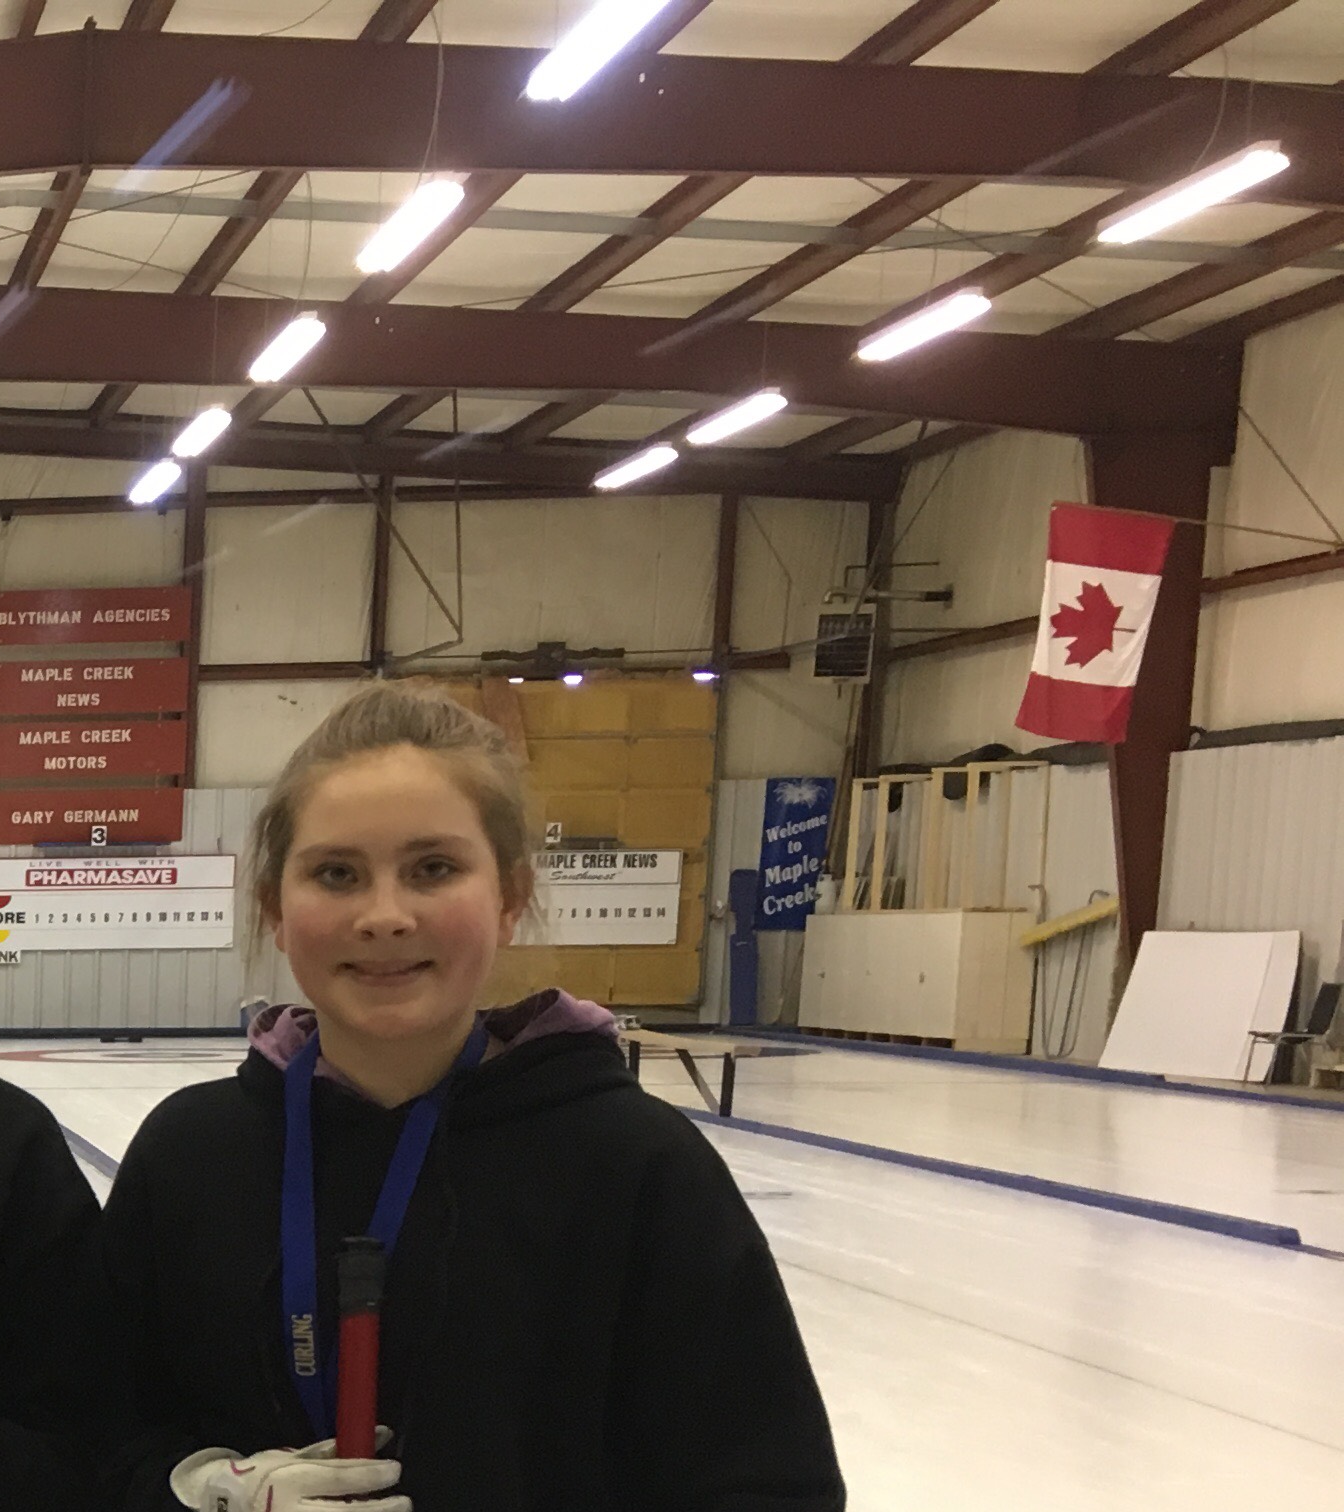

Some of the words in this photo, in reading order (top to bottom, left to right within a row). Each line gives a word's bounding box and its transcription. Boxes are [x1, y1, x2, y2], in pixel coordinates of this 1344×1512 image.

[93, 609, 171, 623] AGENCIES
[21, 668, 73, 682] MAPLE
[83, 666, 135, 681] CREEK
[57, 693, 100, 707] NEWS
[19, 730, 71, 745] MAPLE
[81, 729, 132, 743] CREEK
[44, 756, 107, 770] MOTORS
[11, 811, 54, 824] GARY
[64, 809, 139, 823] GERMANN
[92, 827, 106, 844] 3
[546, 824, 559, 841] 4
[766, 814, 827, 843] Welcome
[787, 840, 802, 854] to
[536, 854, 576, 869] MAPLE
[582, 854, 618, 868] CREEK
[623, 854, 658, 868] NEWS
[29, 869, 173, 885] PHARMASAVE
[549, 870, 616, 881] Southwest
[765, 855, 819, 888] Maple
[763, 882, 816, 915] Creek
[34, 914, 40, 924] 1
[48, 913, 54, 924] 2
[62, 913, 68, 923] 3
[76, 913, 82, 923] 4
[90, 913, 96, 923] 5
[103, 912, 109, 922] 6
[118, 912, 124, 922] 7
[132, 912, 138, 922] 8
[145, 912, 151, 922] 9
[158, 912, 167, 922] 10
[173, 912, 180, 922] 11
[186, 912, 195, 922] 12
[200, 911, 209, 922] 13
[214, 911, 223, 921] 14
[599, 908, 608, 918] 10
[628, 908, 637, 918] 12
[291, 1313, 317, 1377] CURLING
